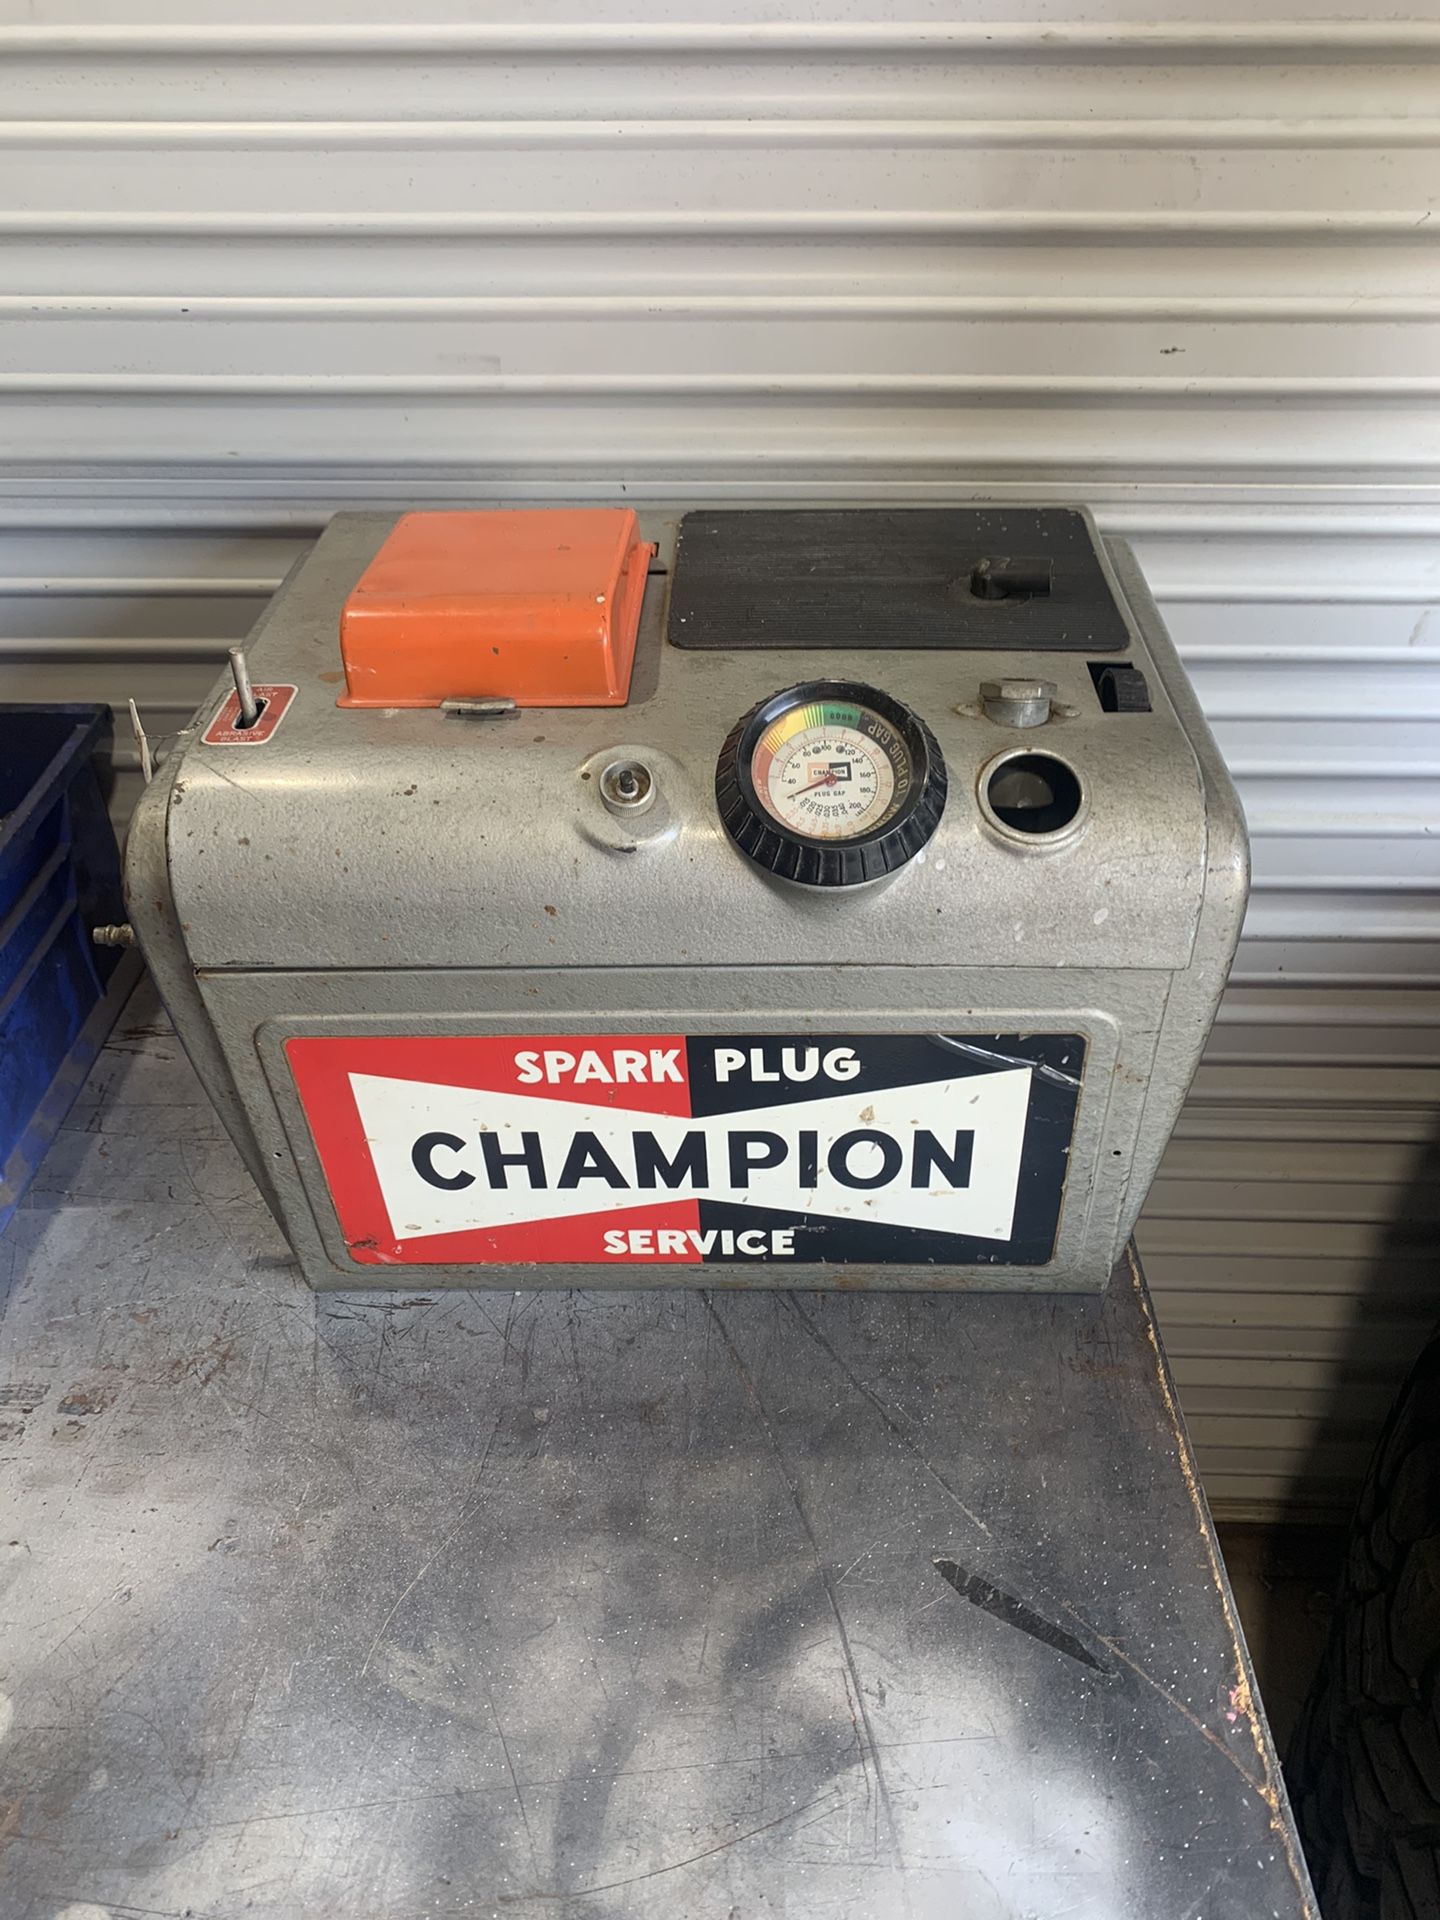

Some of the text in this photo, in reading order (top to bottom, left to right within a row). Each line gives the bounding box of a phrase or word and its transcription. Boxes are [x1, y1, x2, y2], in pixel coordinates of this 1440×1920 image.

[867, 721, 892, 745] GAP
[889, 742, 909, 778] PLUG
[515, 1048, 861, 1084] SPARK PLUG
[412, 1130, 975, 1190] CHAMPION
[604, 1229, 795, 1255] SERVICE
